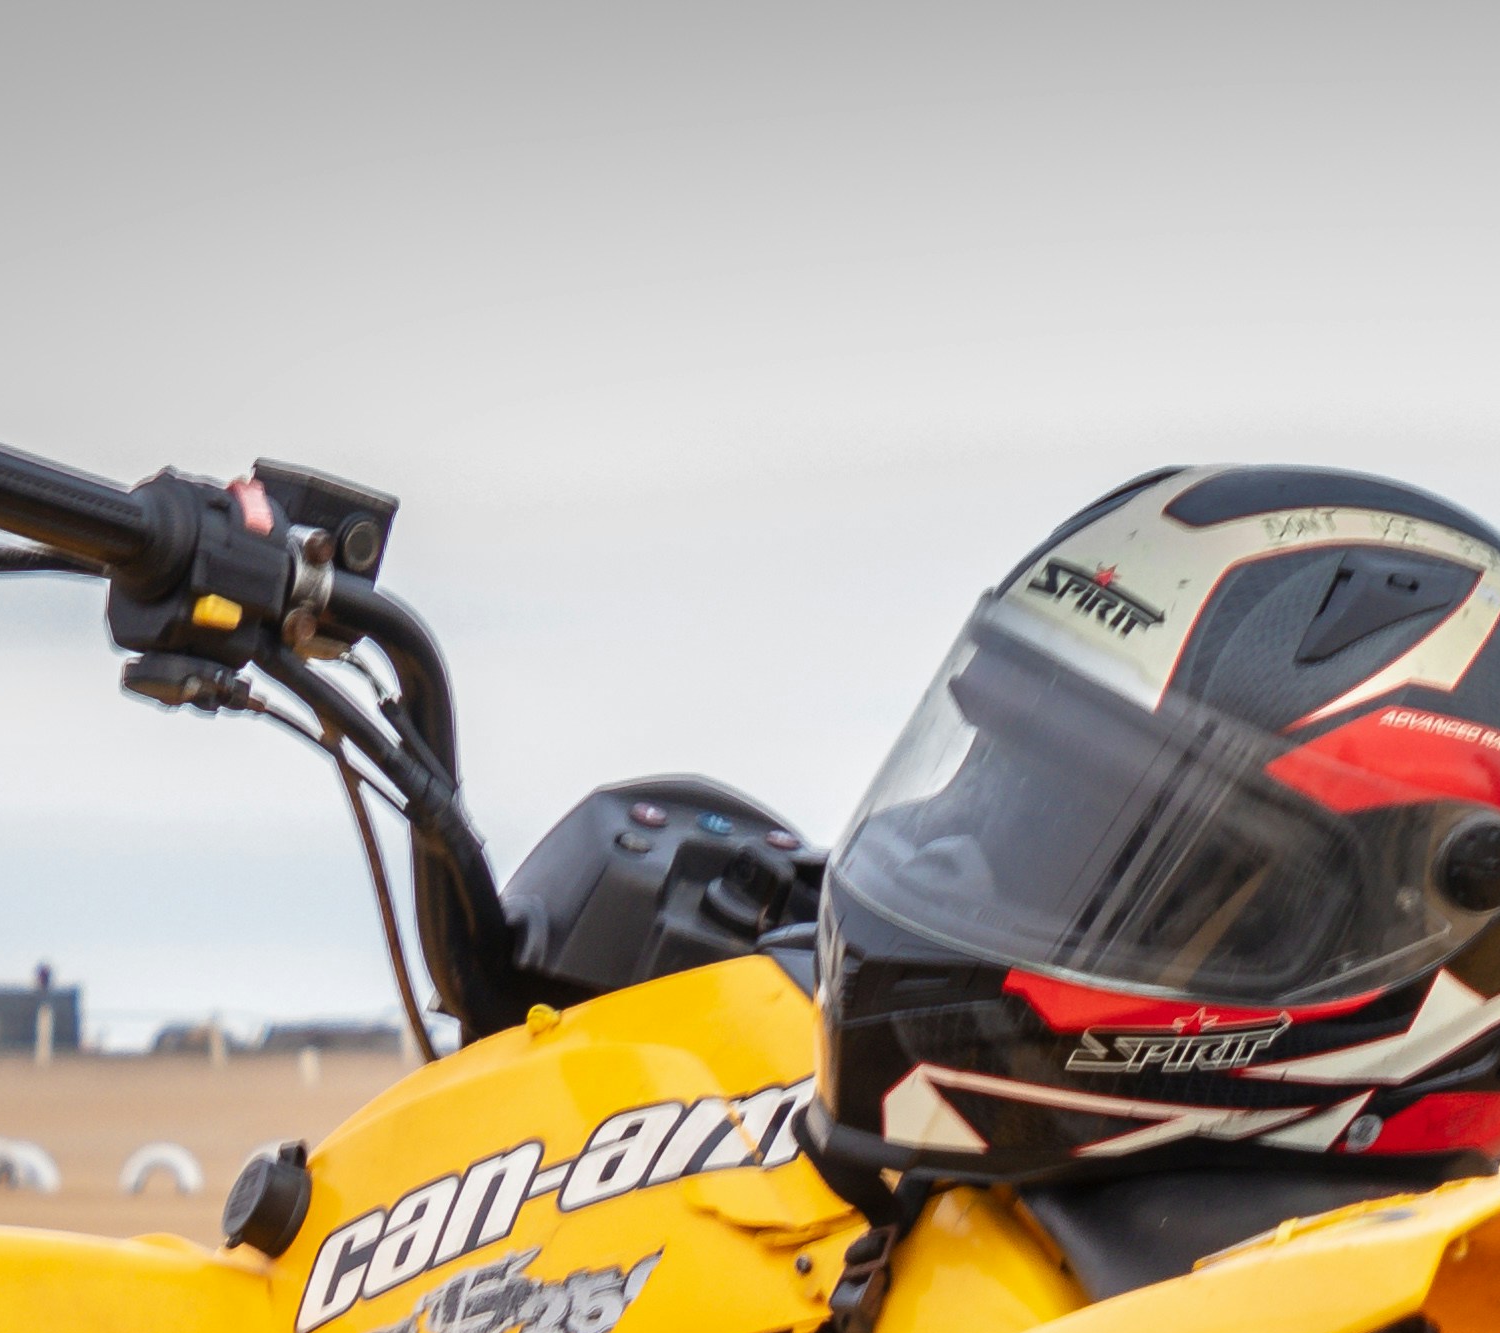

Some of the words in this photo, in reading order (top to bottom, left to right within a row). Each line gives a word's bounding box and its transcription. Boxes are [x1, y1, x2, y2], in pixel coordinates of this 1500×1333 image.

[1025, 558, 1165, 640] SPIRIT
[1380, 710, 1481, 743] ADVANCED
[1065, 1010, 1293, 1073] SPIRIT
